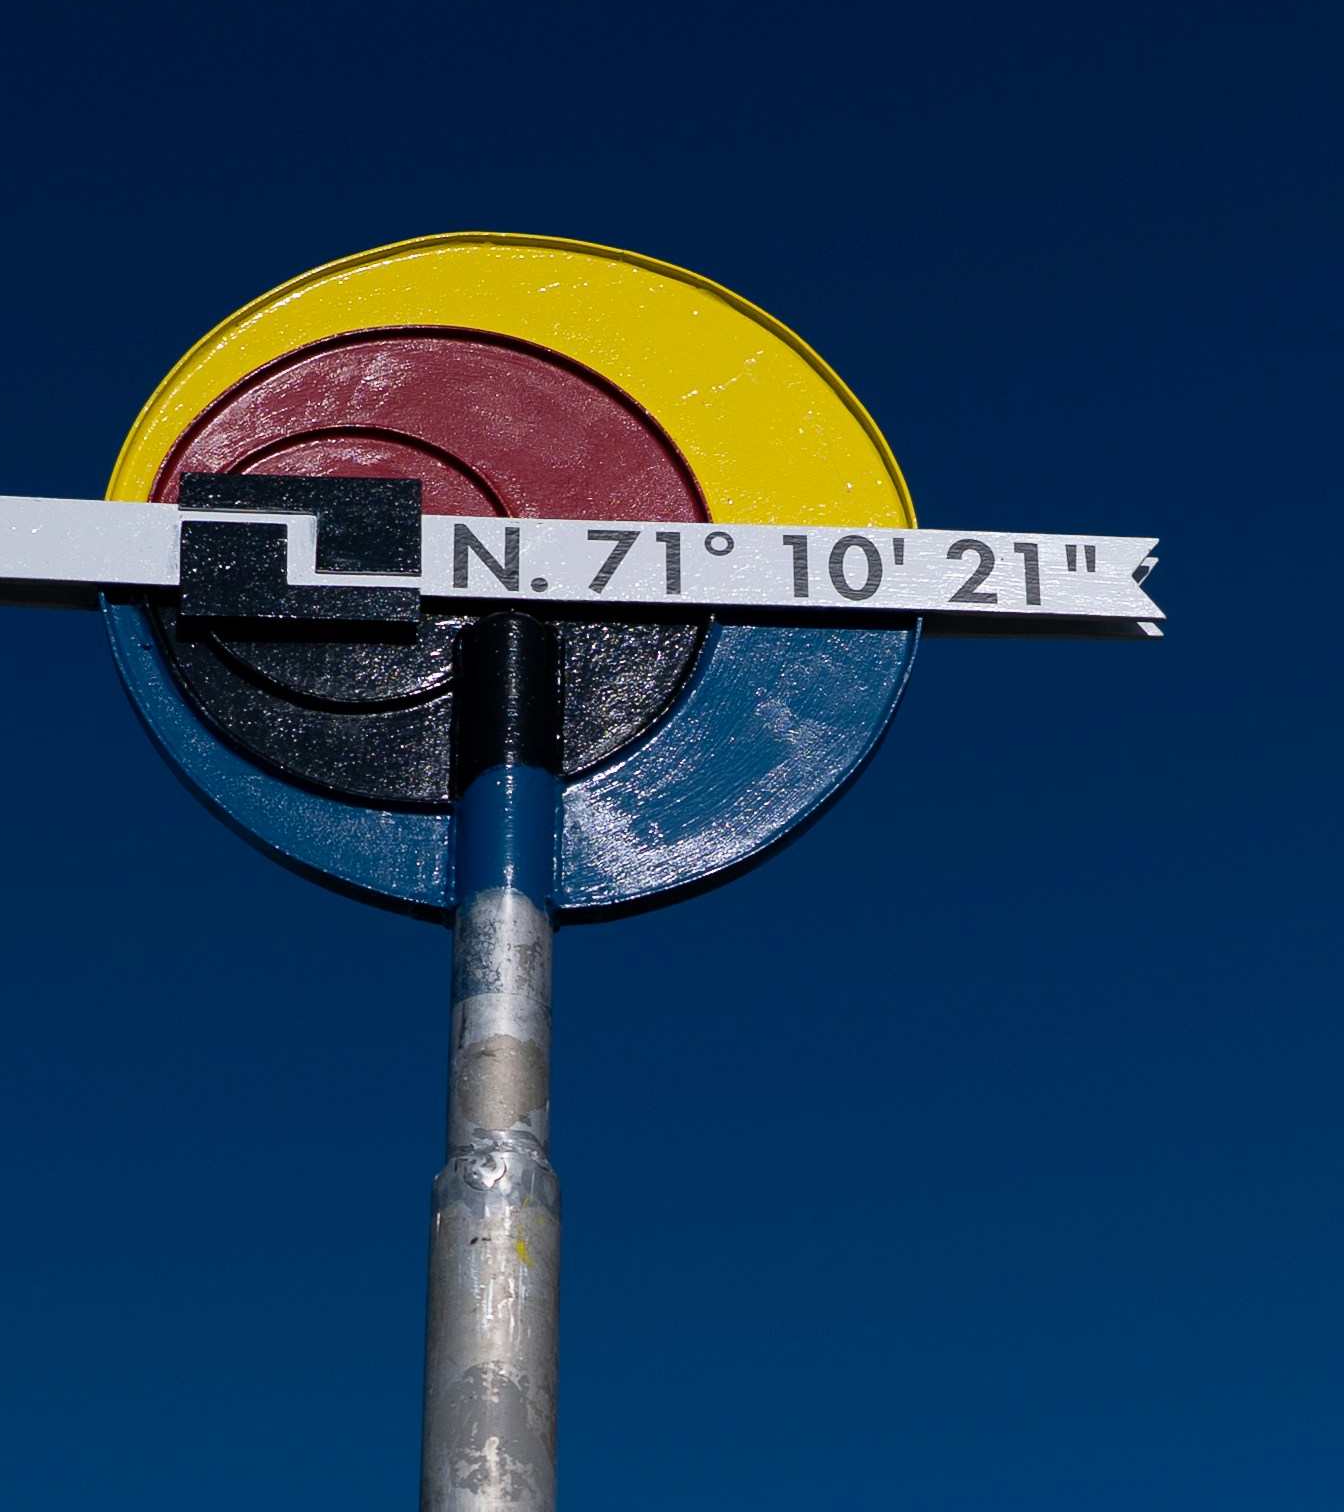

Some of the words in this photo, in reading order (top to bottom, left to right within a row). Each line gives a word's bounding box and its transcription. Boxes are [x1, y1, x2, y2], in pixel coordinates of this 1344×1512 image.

[454, 523, 549, 594] N.
[586, 529, 735, 595] 71°
[782, 533, 906, 602] 10'
[945, 538, 1097, 606] 21"
